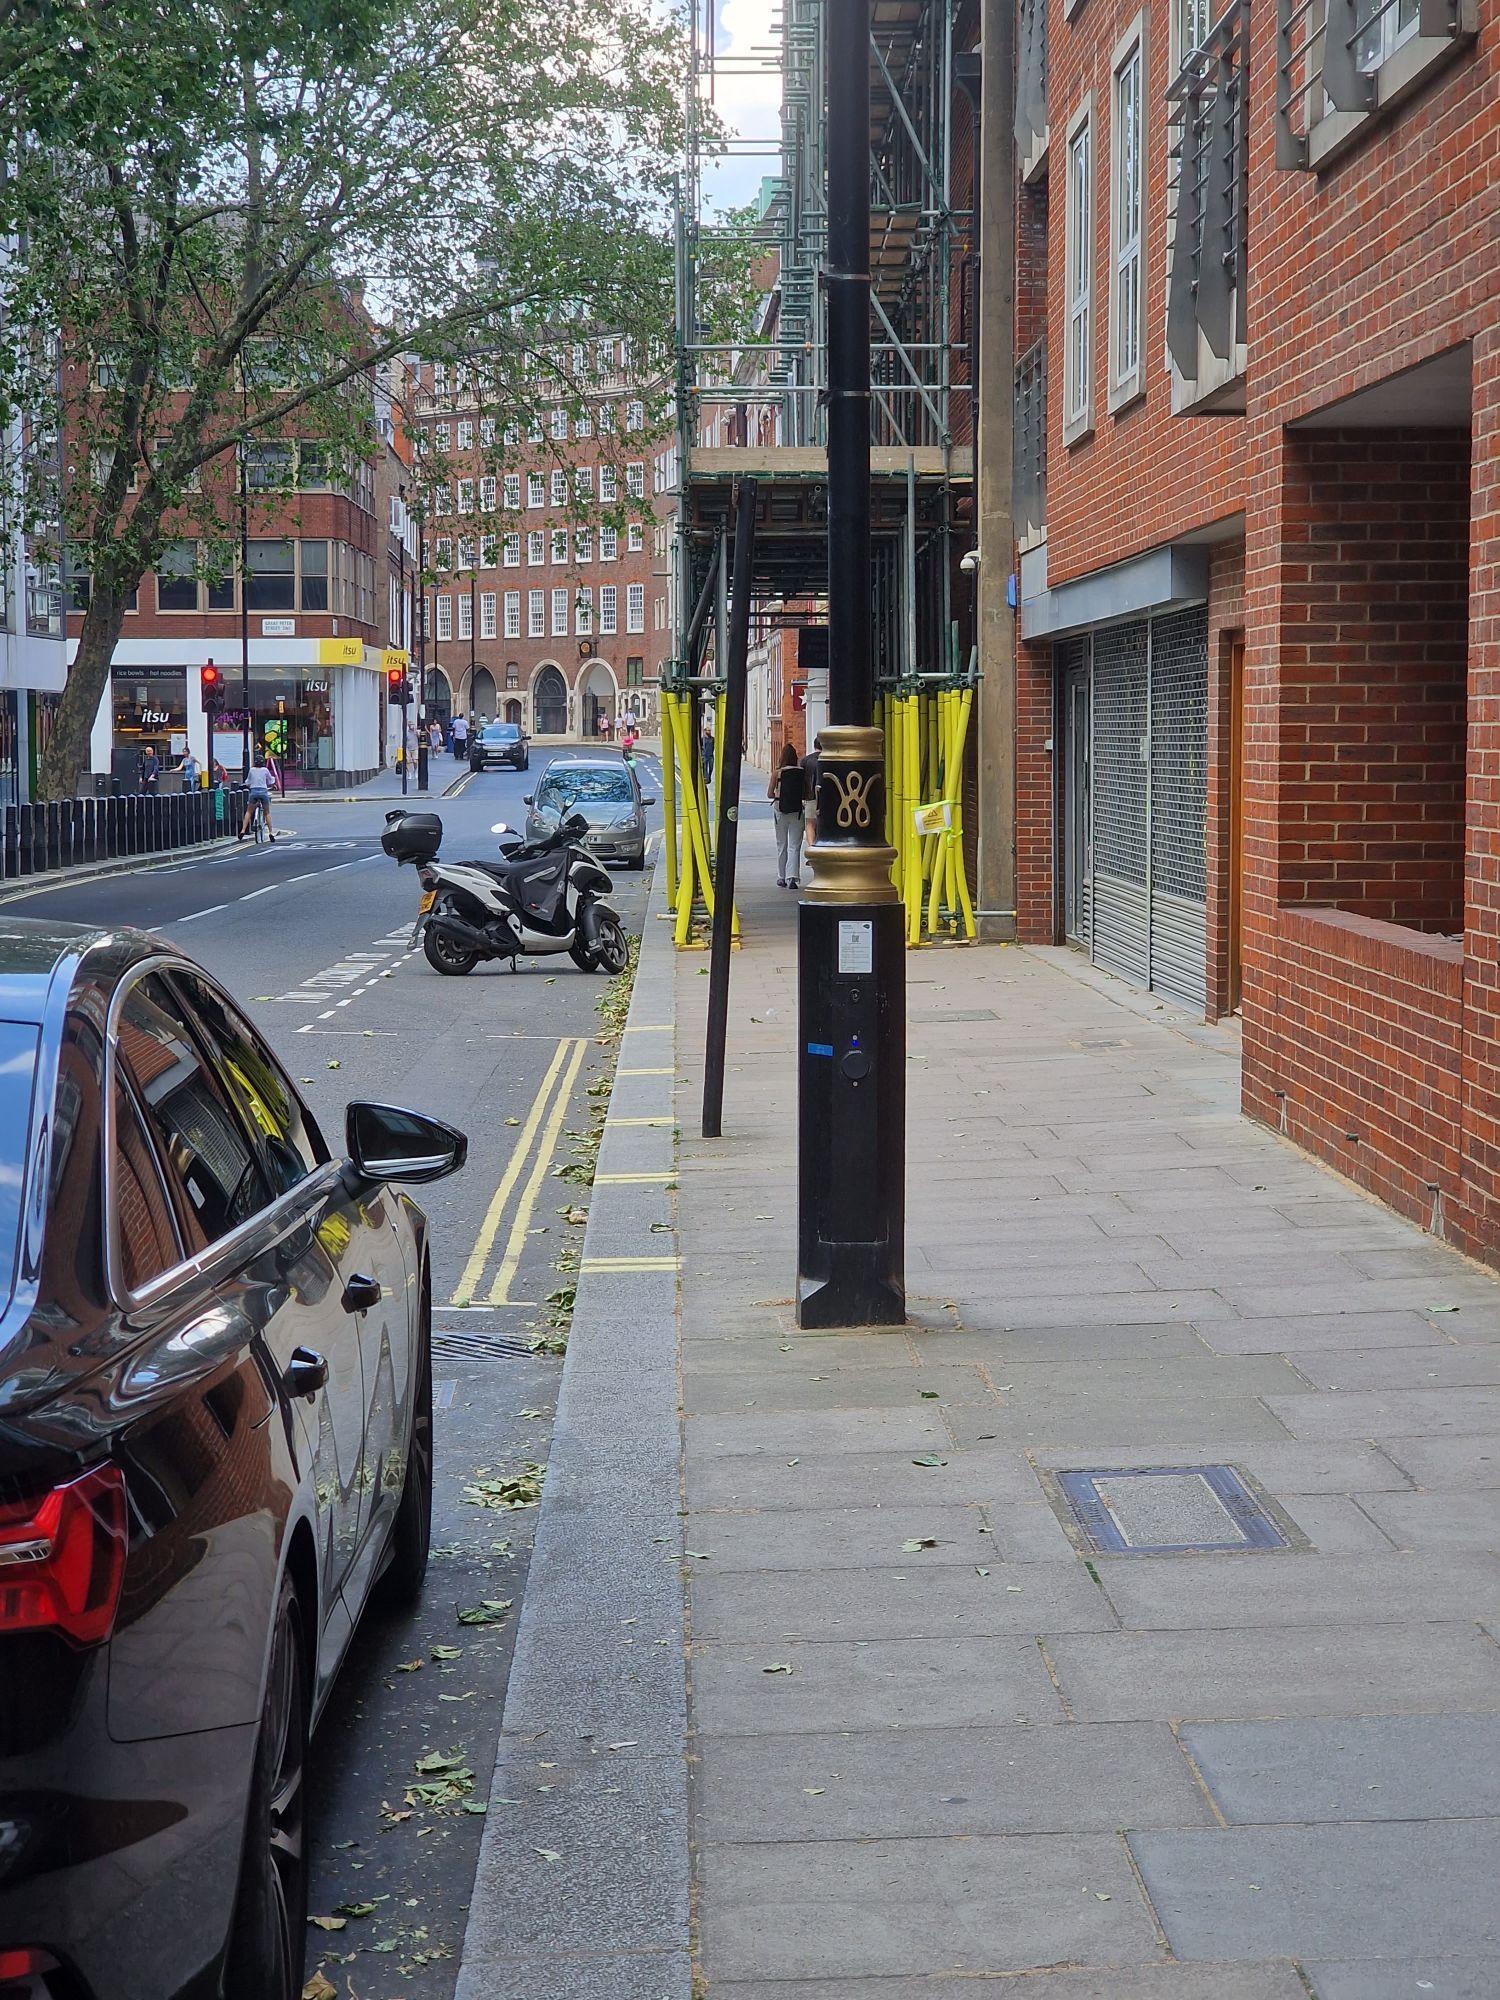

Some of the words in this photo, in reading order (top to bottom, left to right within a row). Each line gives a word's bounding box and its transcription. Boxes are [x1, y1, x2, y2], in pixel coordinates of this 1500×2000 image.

[343, 645, 357, 655] itsu
[386, 655, 405, 665] itsu
[306, 678, 328, 692] itsu
[141, 708, 170, 723] itsu
